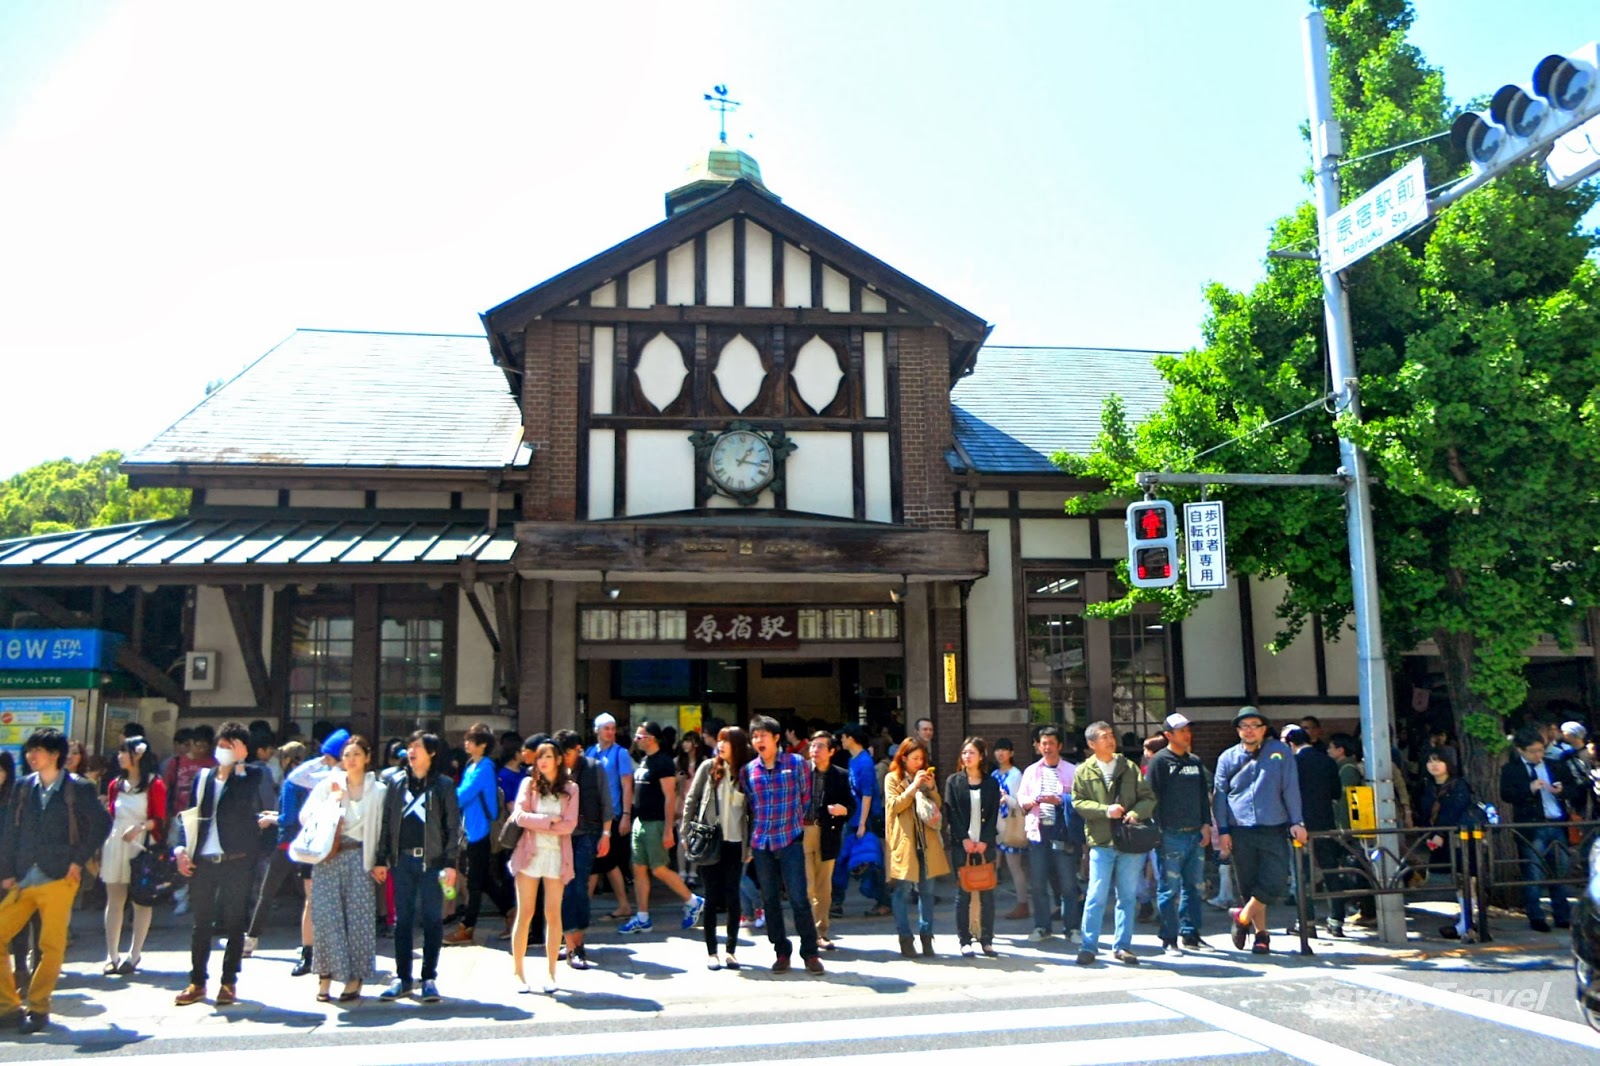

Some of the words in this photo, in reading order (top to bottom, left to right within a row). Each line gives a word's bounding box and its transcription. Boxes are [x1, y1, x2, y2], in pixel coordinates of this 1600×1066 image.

[1336, 174, 1415, 243] 原宿駅前
[1343, 226, 1384, 257] Harajuku
[1391, 210, 1408, 228] Sta
[1190, 509, 1205, 553] 自転車
[1204, 509, 1220, 552] 歩行者
[1199, 553, 1214, 582] 専用
[693, 613, 793, 644] 原宿駅
[51, 650, 84, 660] コーナー
[53, 639, 82, 651] ATM
[0, 676, 62, 684] IEWALTTE
